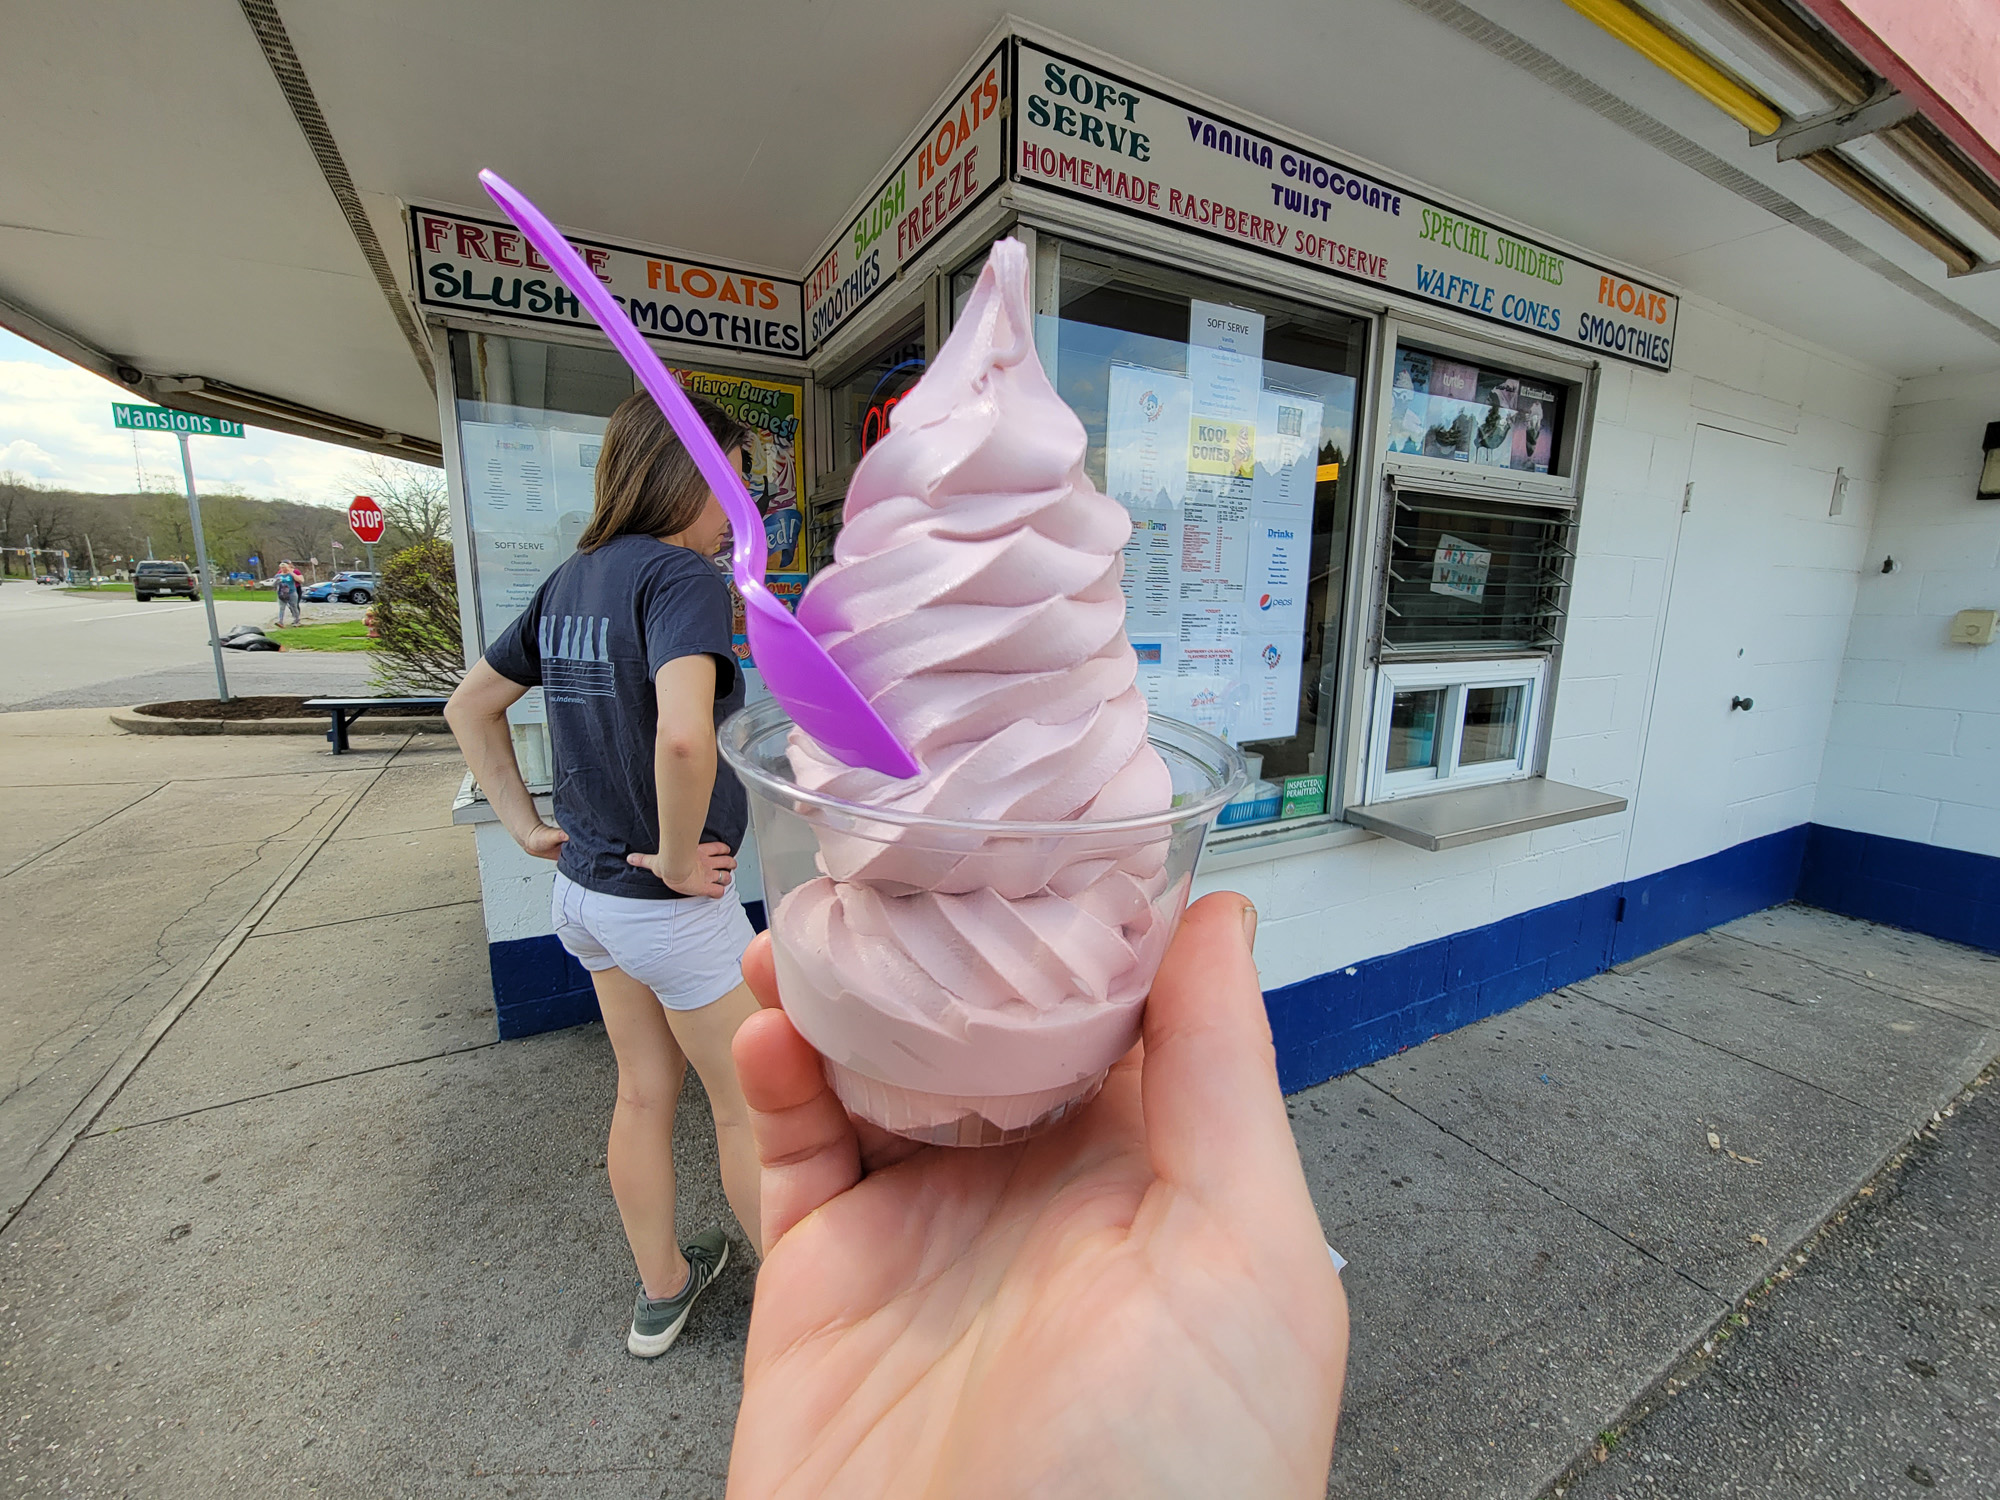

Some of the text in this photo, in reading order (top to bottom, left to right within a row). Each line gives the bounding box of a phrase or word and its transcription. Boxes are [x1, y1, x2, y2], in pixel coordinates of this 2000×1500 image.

[1045, 63, 1140, 123] SOFT
[918, 68, 998, 190] FLOATS
[1027, 95, 1150, 162] SERVE
[1187, 116, 1401, 217] VANILLA CHOCOLATE
[854, 170, 906, 260] SLUSH
[897, 145, 979, 261] FREEZE
[1022, 141, 1389, 280] HOMEMADE RASPBERRY SOFTSERVE
[1271, 182, 1332, 222] TWIST
[423, 217, 612, 283] FREEE
[1419, 208, 1565, 286] SPECIAL SUNDAES
[429, 262, 580, 318] SLUSH
[647, 260, 779, 311] FLOATS
[805, 251, 839, 311] LATTE
[811, 249, 880, 341] SMOOTHIES
[1416, 263, 1560, 332] WAFFLE CONES
[1598, 275, 1667, 325] FLOATS
[1207, 317, 1249, 335] SOFT SERVE
[1578, 312, 1670, 364] SMOOTHIES
[692, 375, 737, 397] Flavor
[739, 381, 781, 408] Burst
[116, 406, 241, 435] Mansions Dr
[739, 403, 799, 441] Cones!
[1198, 425, 1230, 444] KOOL
[1192, 445, 1231, 463] CONES
[351, 509, 382, 528] STOP
[1267, 528, 1294, 540] Drinks
[494, 541, 545, 550] SOFT SERVE
[765, 582, 802, 595] OWLS
[1273, 598, 1293, 607] pepsi
[1286, 787, 1317, 798] PERMITTED
[1287, 779, 1317, 790] INSPECTED
